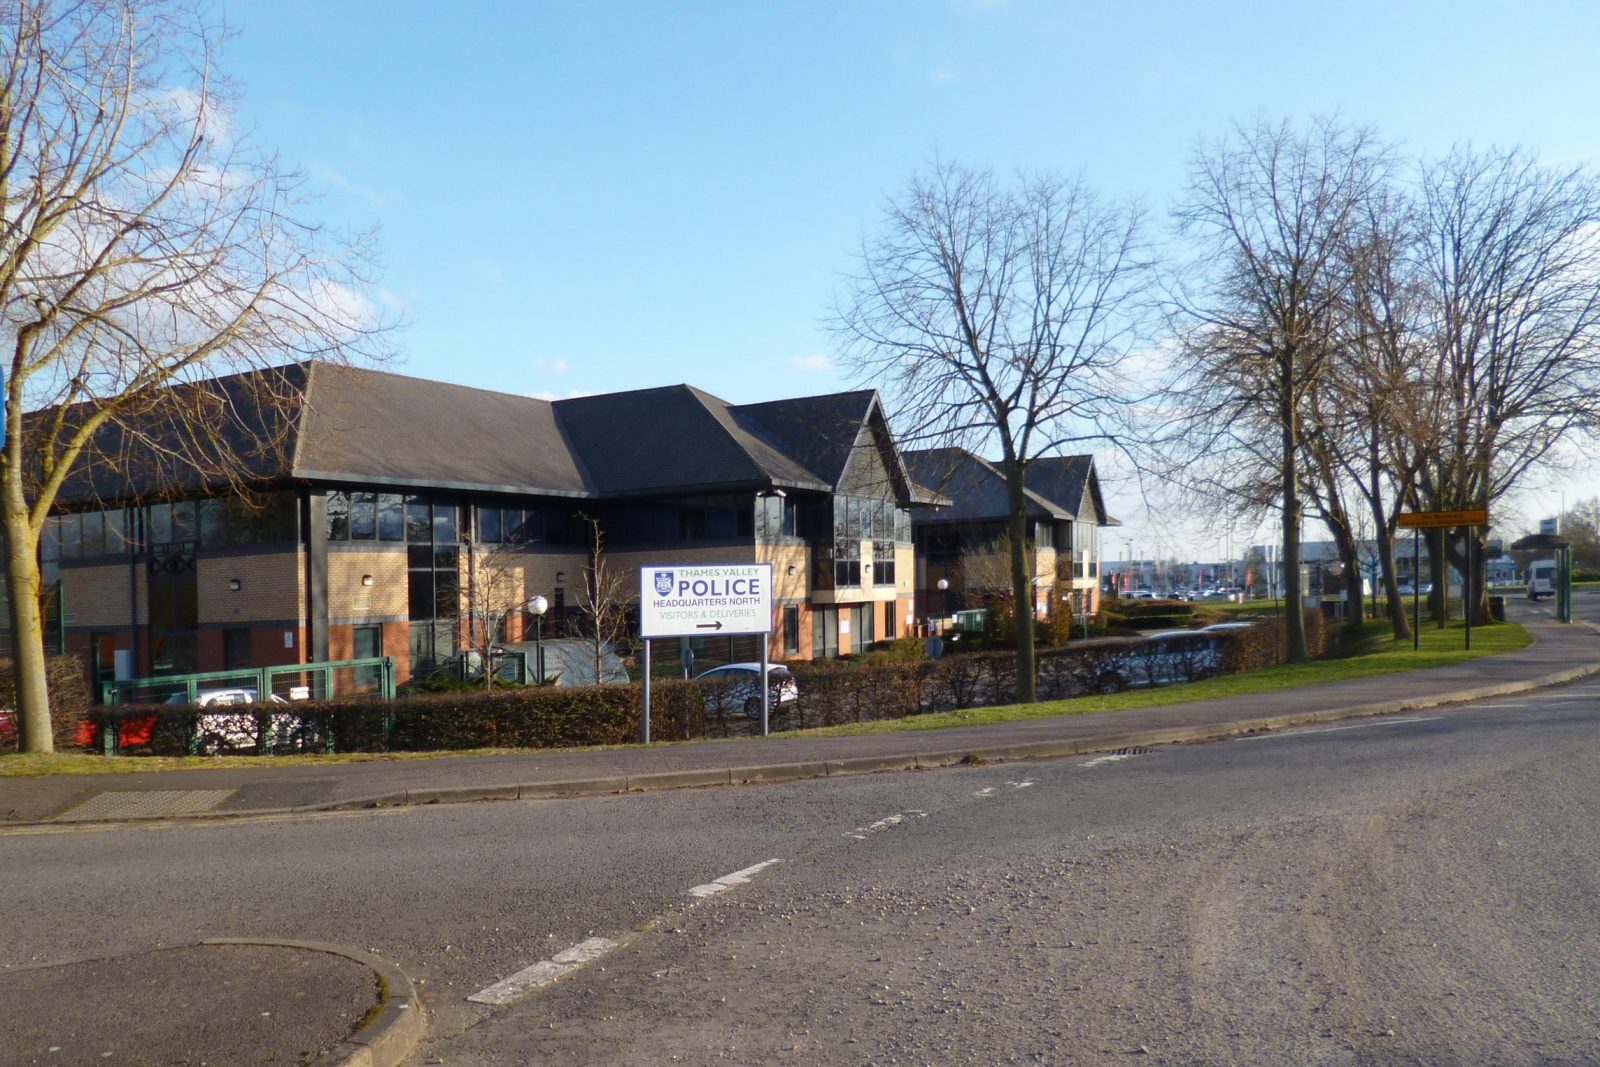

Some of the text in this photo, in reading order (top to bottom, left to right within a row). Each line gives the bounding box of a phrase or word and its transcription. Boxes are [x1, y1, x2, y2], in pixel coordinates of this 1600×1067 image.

[678, 568, 759, 577] THAMES VALLEY
[678, 579, 760, 597] POLICE
[653, 597, 760, 607] HEADQUARTERS NORTH
[660, 609, 756, 620] VISITORS & DELIVERIES
